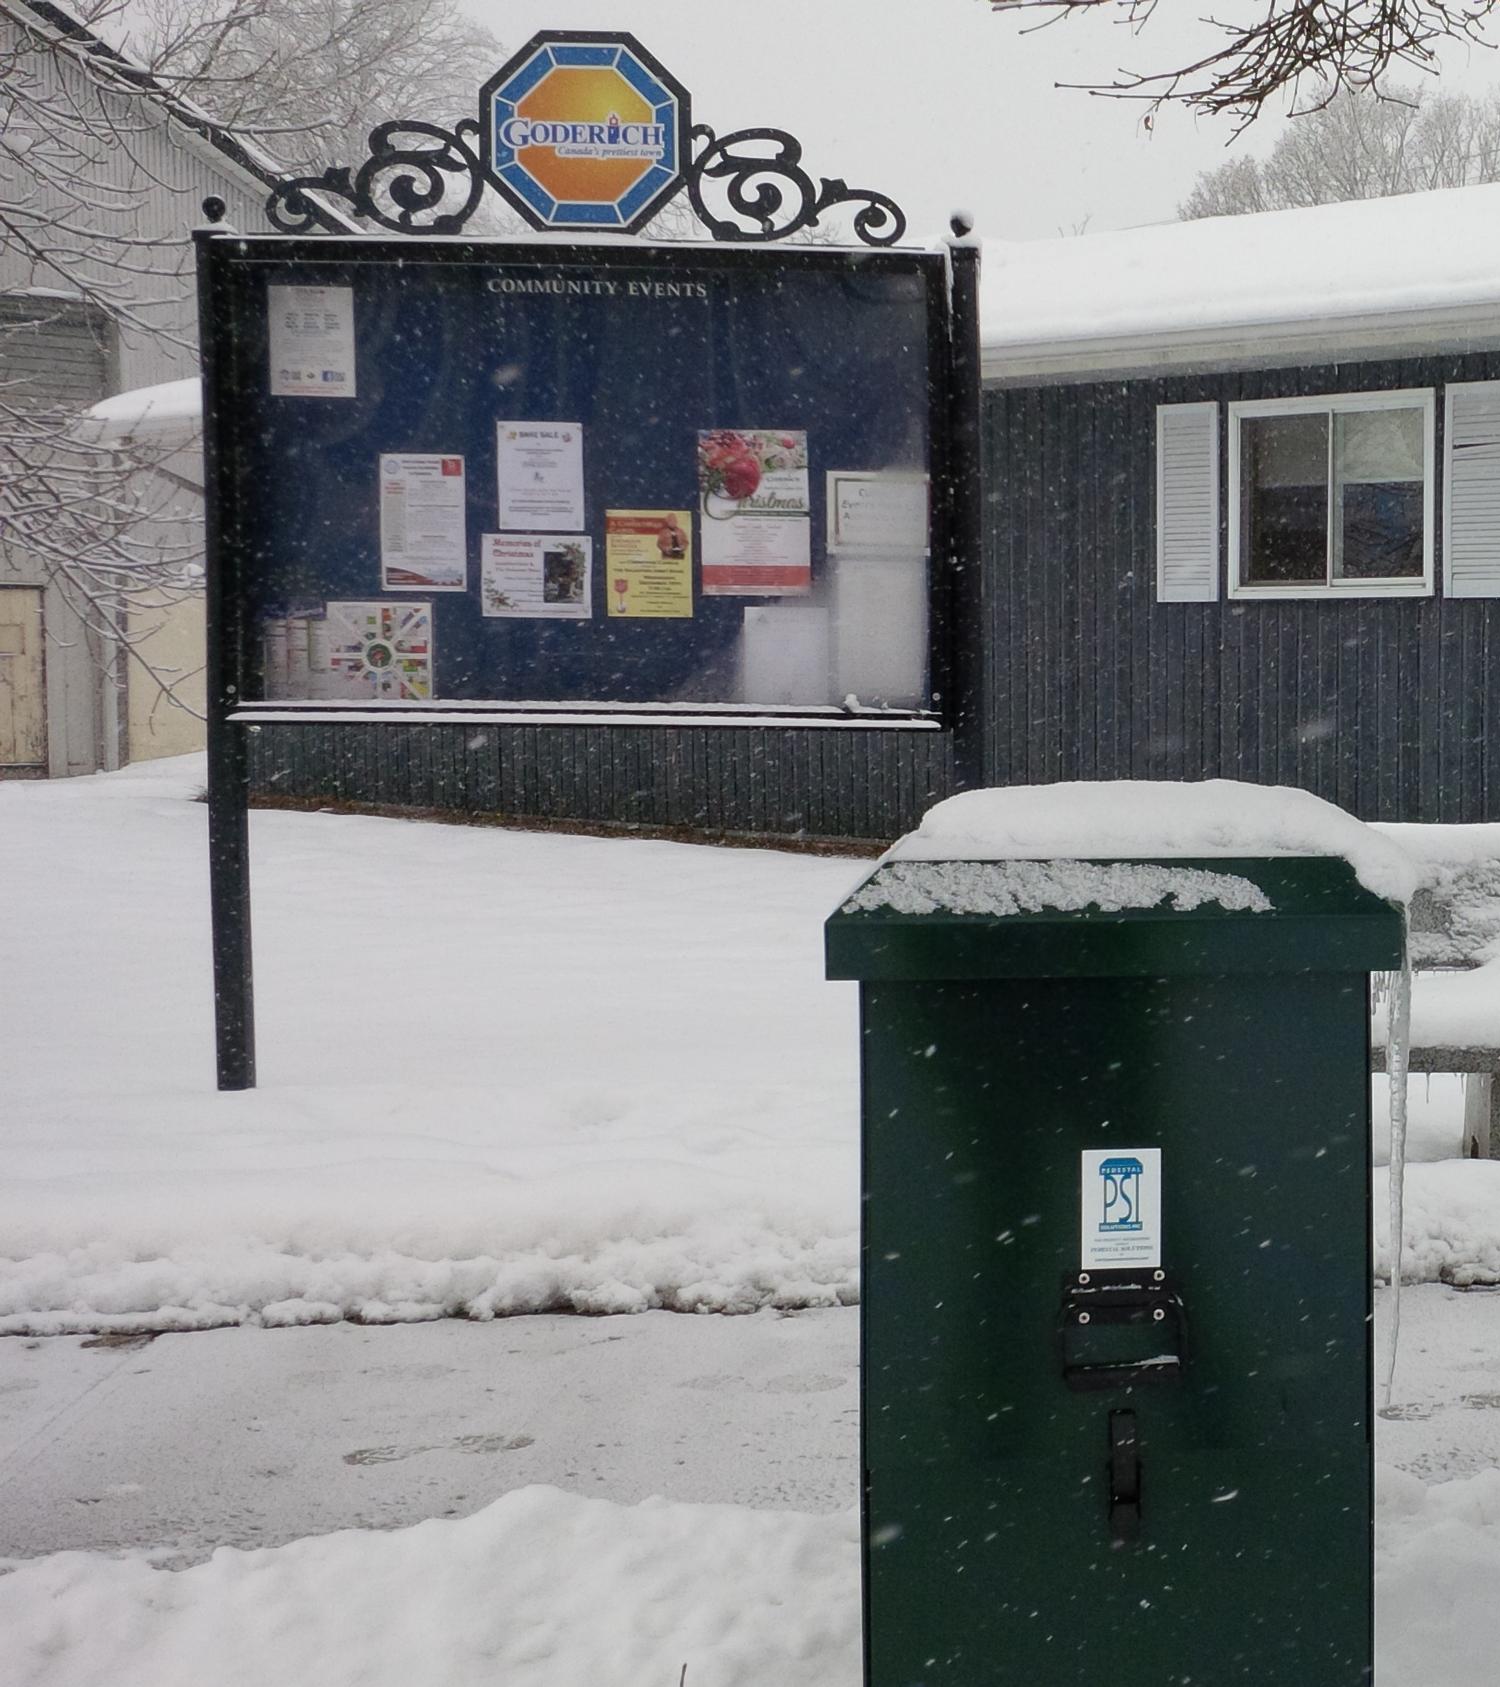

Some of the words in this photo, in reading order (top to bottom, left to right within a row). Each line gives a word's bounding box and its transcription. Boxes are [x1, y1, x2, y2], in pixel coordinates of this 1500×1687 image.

[503, 118, 663, 146] GODERICH
[558, 146, 599, 155] Canada's
[640, 149, 662, 157] town
[487, 278, 617, 295] COMMUNITY
[628, 282, 707, 297] EVENTS
